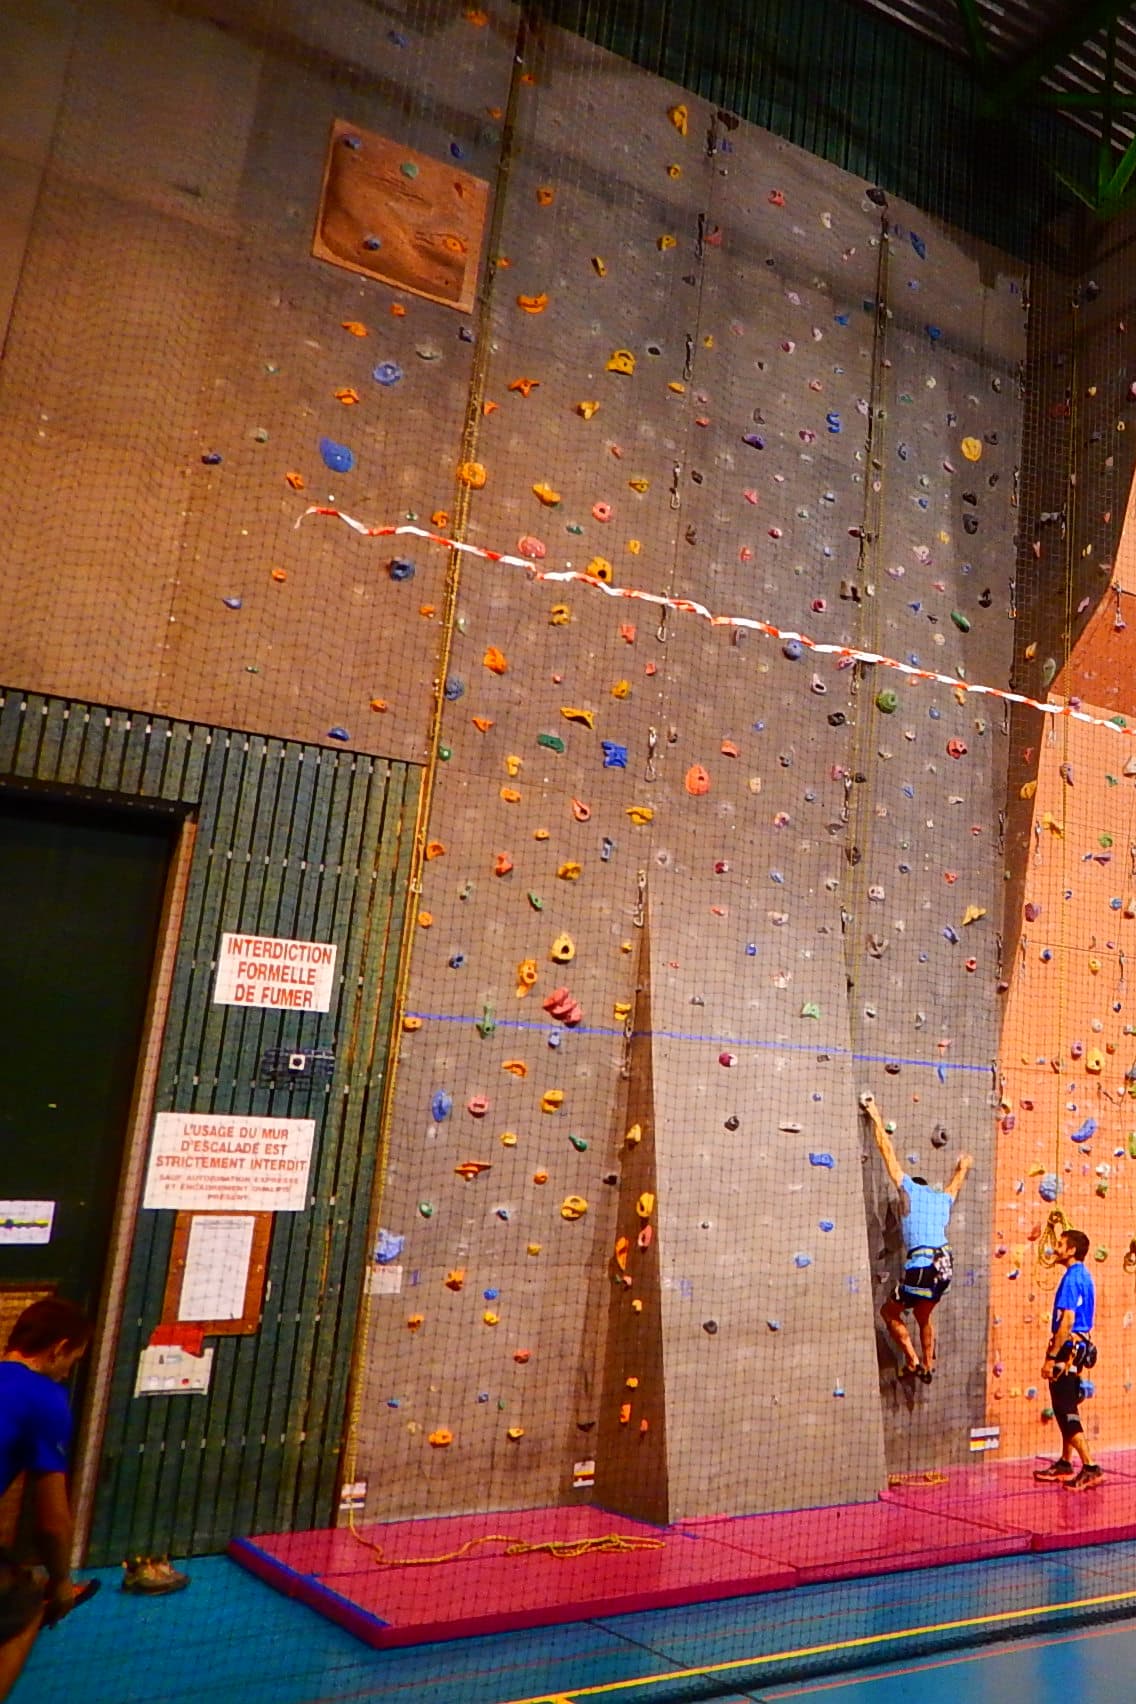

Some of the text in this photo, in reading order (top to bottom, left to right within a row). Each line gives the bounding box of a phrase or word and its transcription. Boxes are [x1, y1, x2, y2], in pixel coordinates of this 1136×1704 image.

[227, 937, 332, 964] INTERDICTION
[237, 961, 316, 986] FORMELLE
[234, 983, 313, 1008] DE FUMER
[183, 1124, 289, 1140] L'USAGE DU MUR
[180, 1140, 288, 1156] D'ESCALADE EST
[156, 1155, 307, 1171] STRICTEMENT INTERDIT
